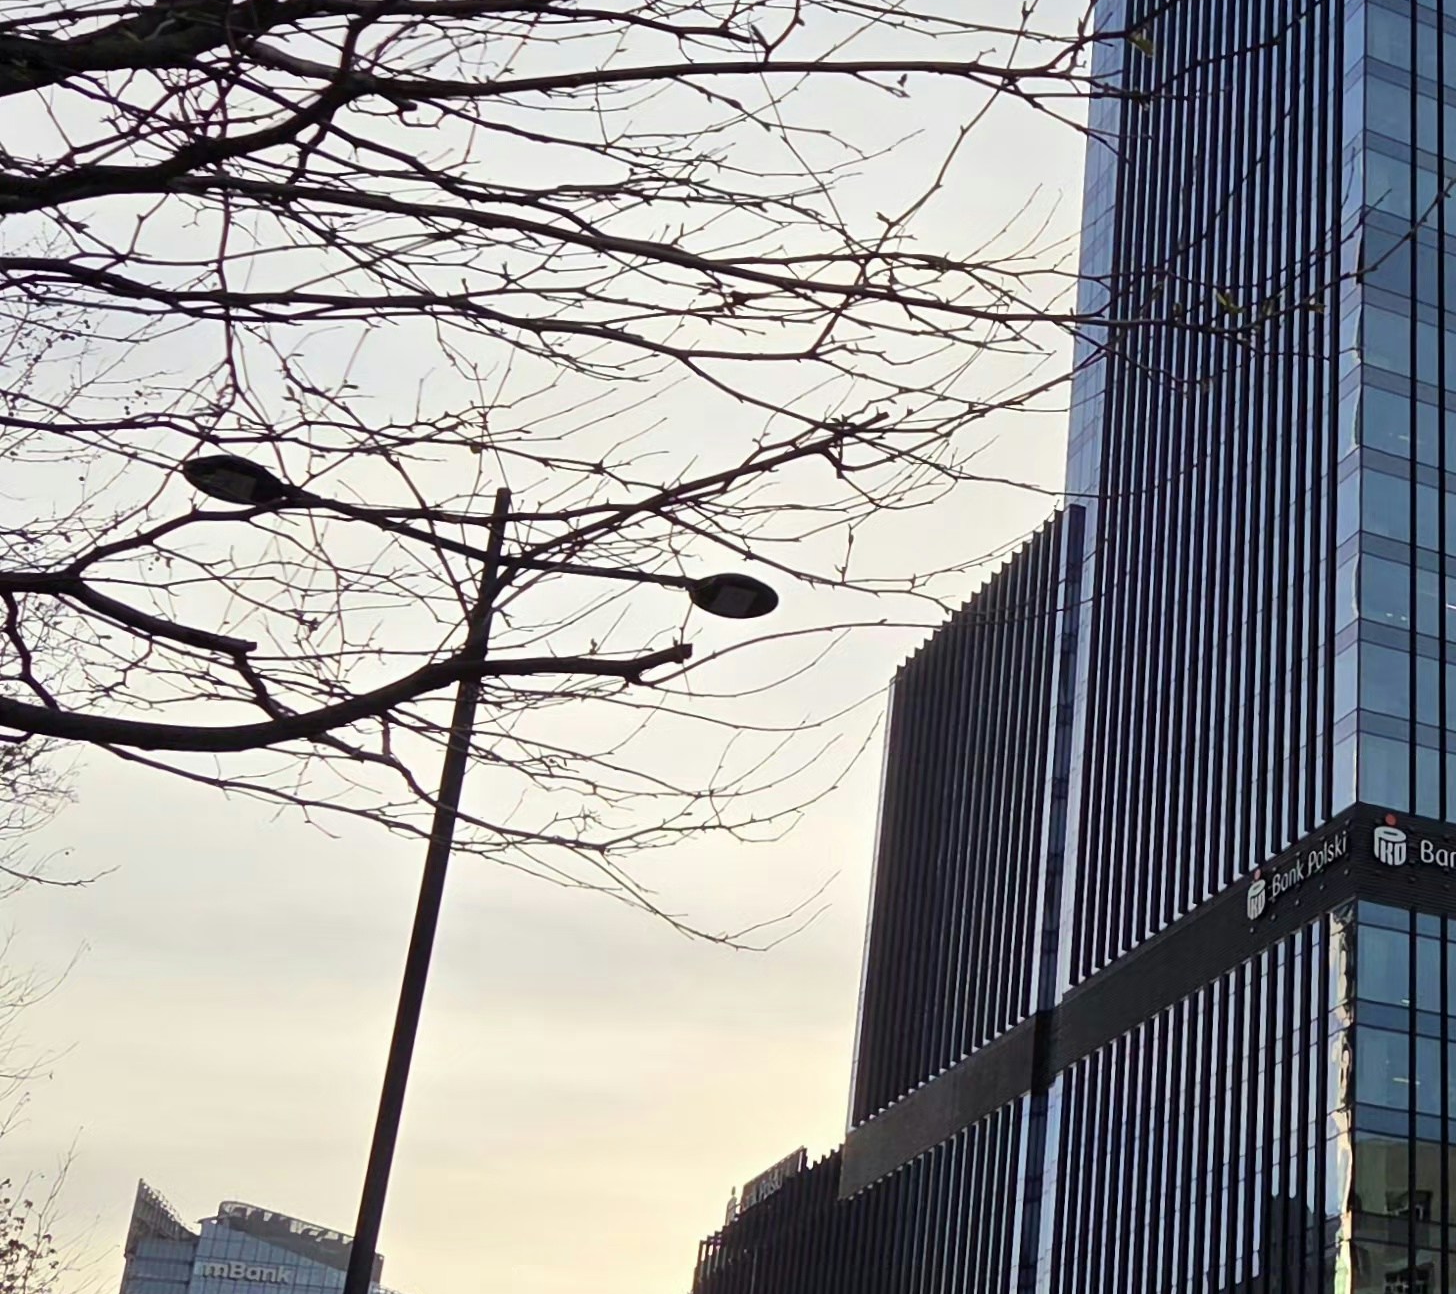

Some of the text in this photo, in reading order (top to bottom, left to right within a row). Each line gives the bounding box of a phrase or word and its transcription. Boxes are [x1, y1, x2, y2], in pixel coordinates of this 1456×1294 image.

[1272, 858, 1305, 898] Bank
[1307, 829, 1348, 879] Polski
[203, 1261, 292, 1283] mBank
